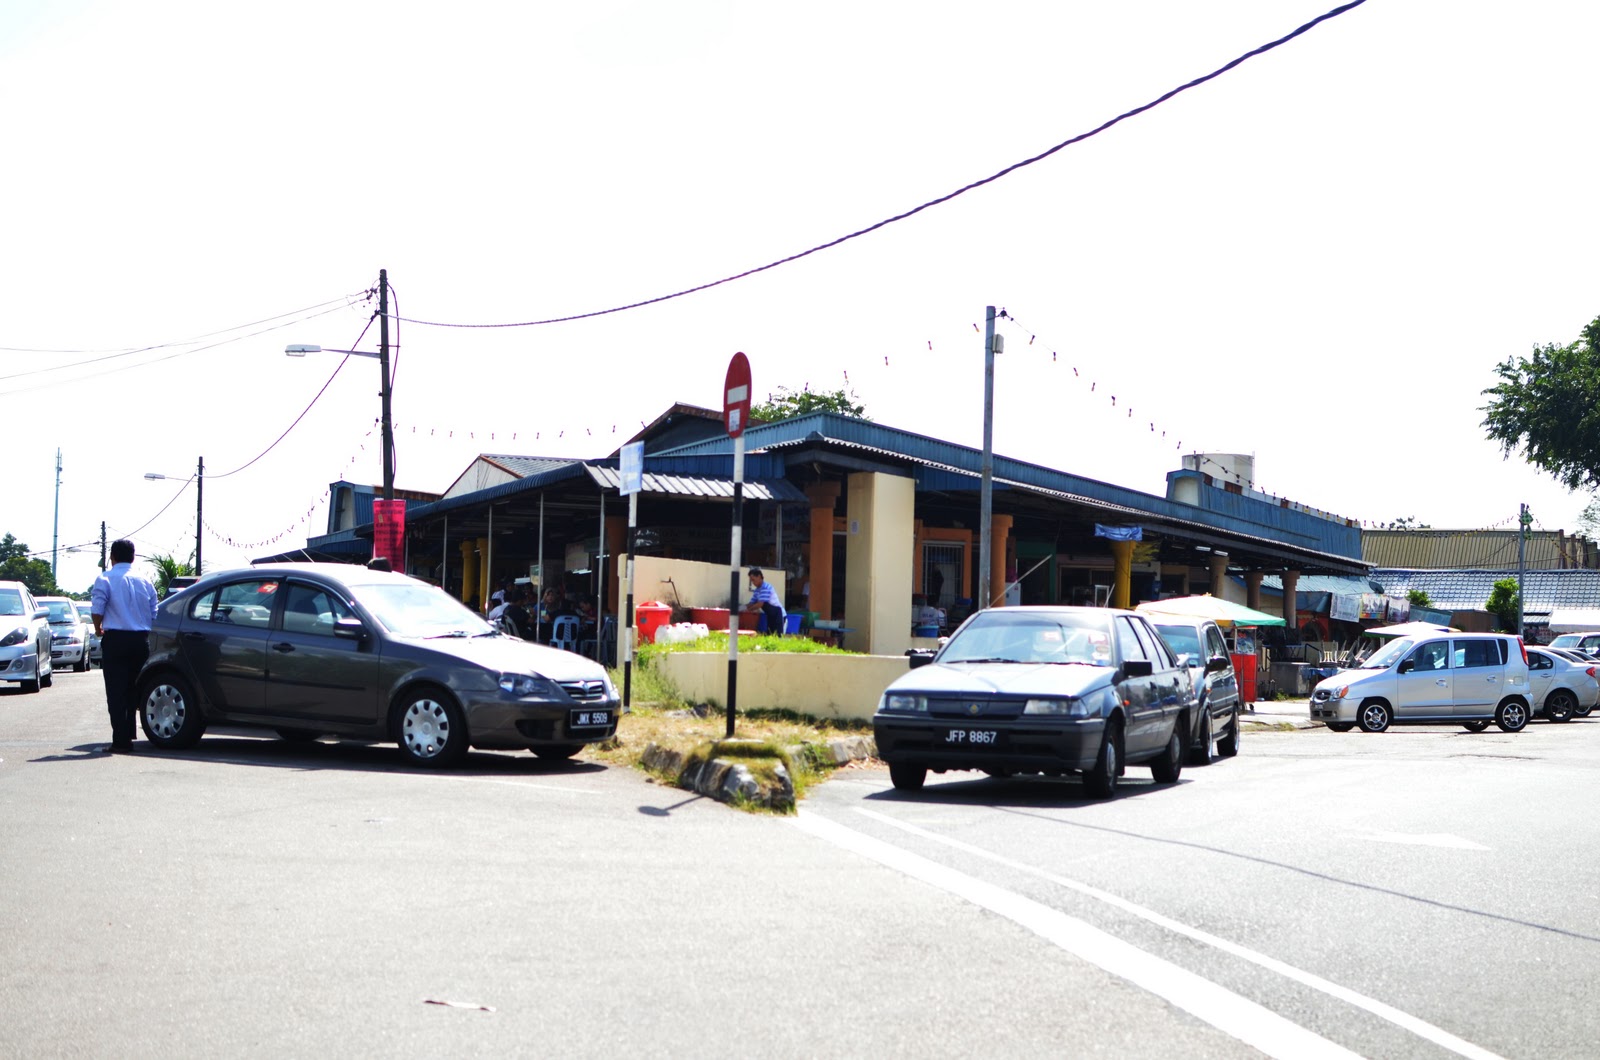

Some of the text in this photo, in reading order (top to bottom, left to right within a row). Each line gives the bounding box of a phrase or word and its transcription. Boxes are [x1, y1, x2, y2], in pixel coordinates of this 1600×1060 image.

[592, 712, 607, 723] 5509
[945, 730, 997, 743] JFP 8867
